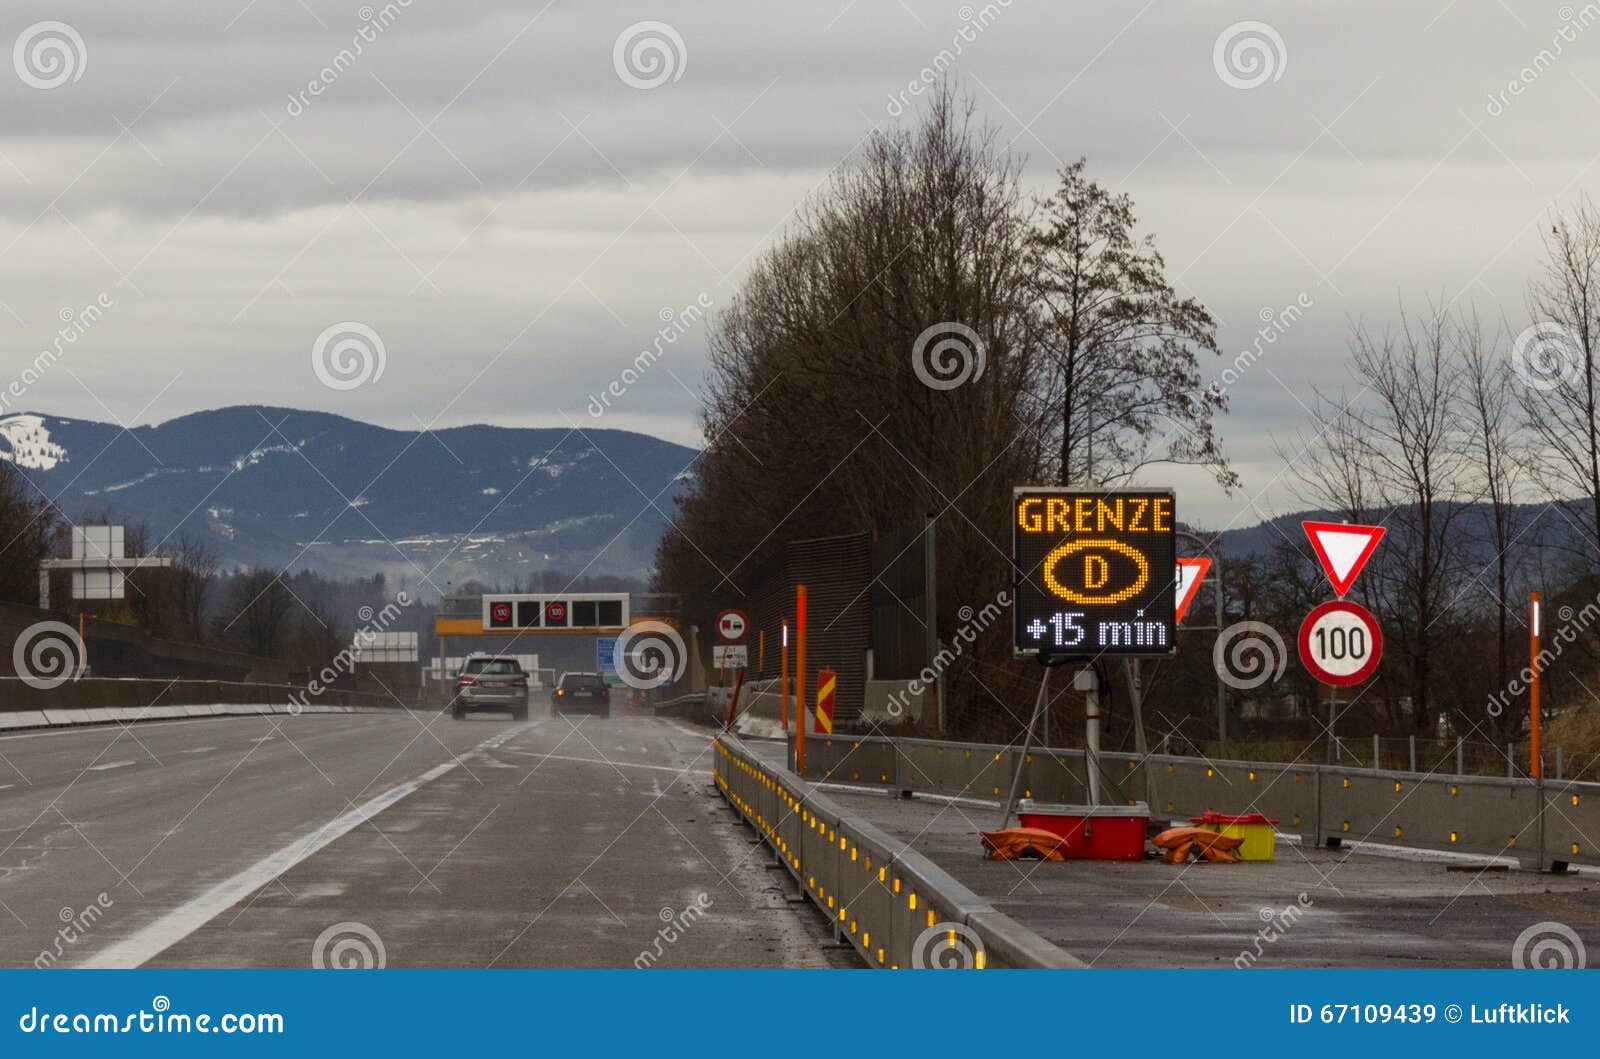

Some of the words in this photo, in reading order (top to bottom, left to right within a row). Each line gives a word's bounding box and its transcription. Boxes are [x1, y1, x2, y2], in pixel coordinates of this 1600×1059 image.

[1018, 498, 1170, 532] GRENZE
[1085, 555, 1108, 589] D
[1027, 612, 1085, 646] +15
[1099, 609, 1166, 646] min
[1315, 627, 1365, 660] 100
